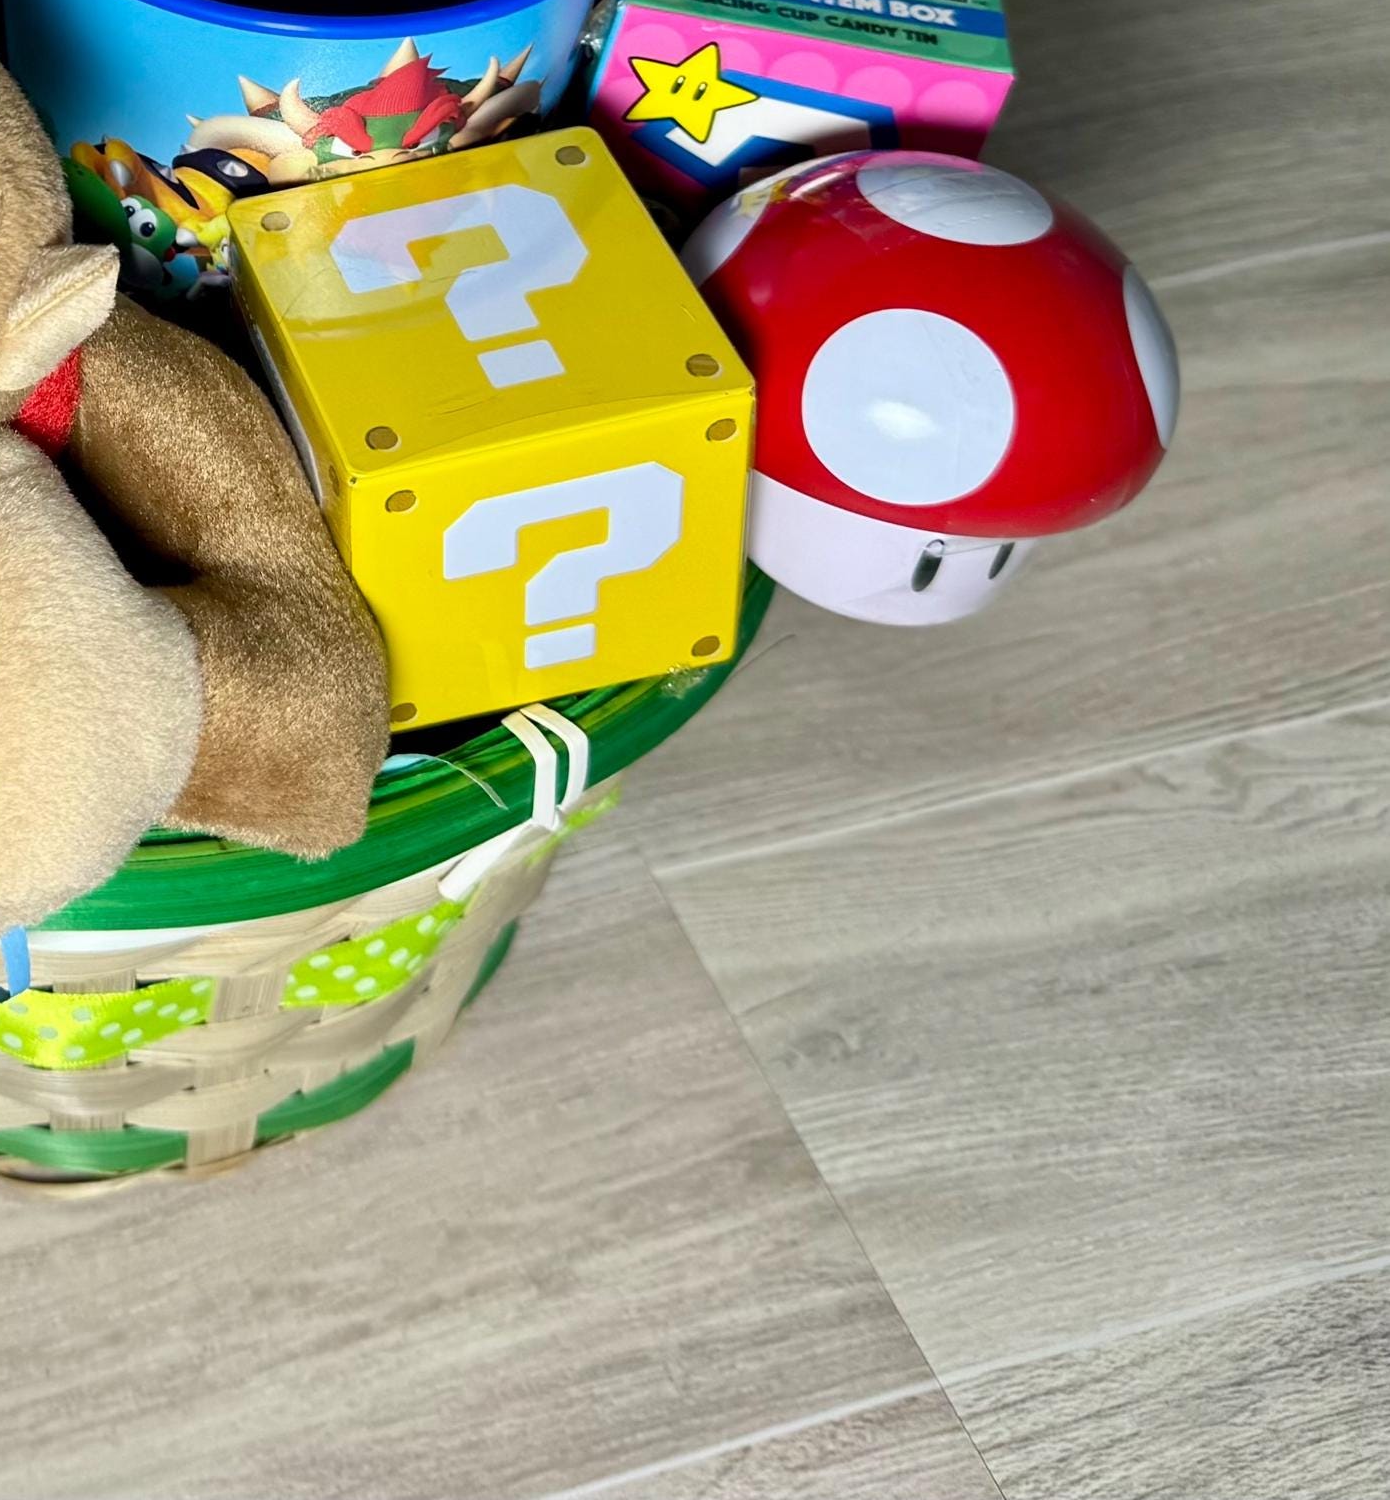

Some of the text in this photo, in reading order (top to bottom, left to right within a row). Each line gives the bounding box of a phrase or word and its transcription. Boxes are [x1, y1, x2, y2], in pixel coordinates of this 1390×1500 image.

[776, 6, 818, 22] CUP
[825, 14, 898, 37] CANDY
[902, 28, 939, 45] TIN
[889, 0, 958, 27] BOX
